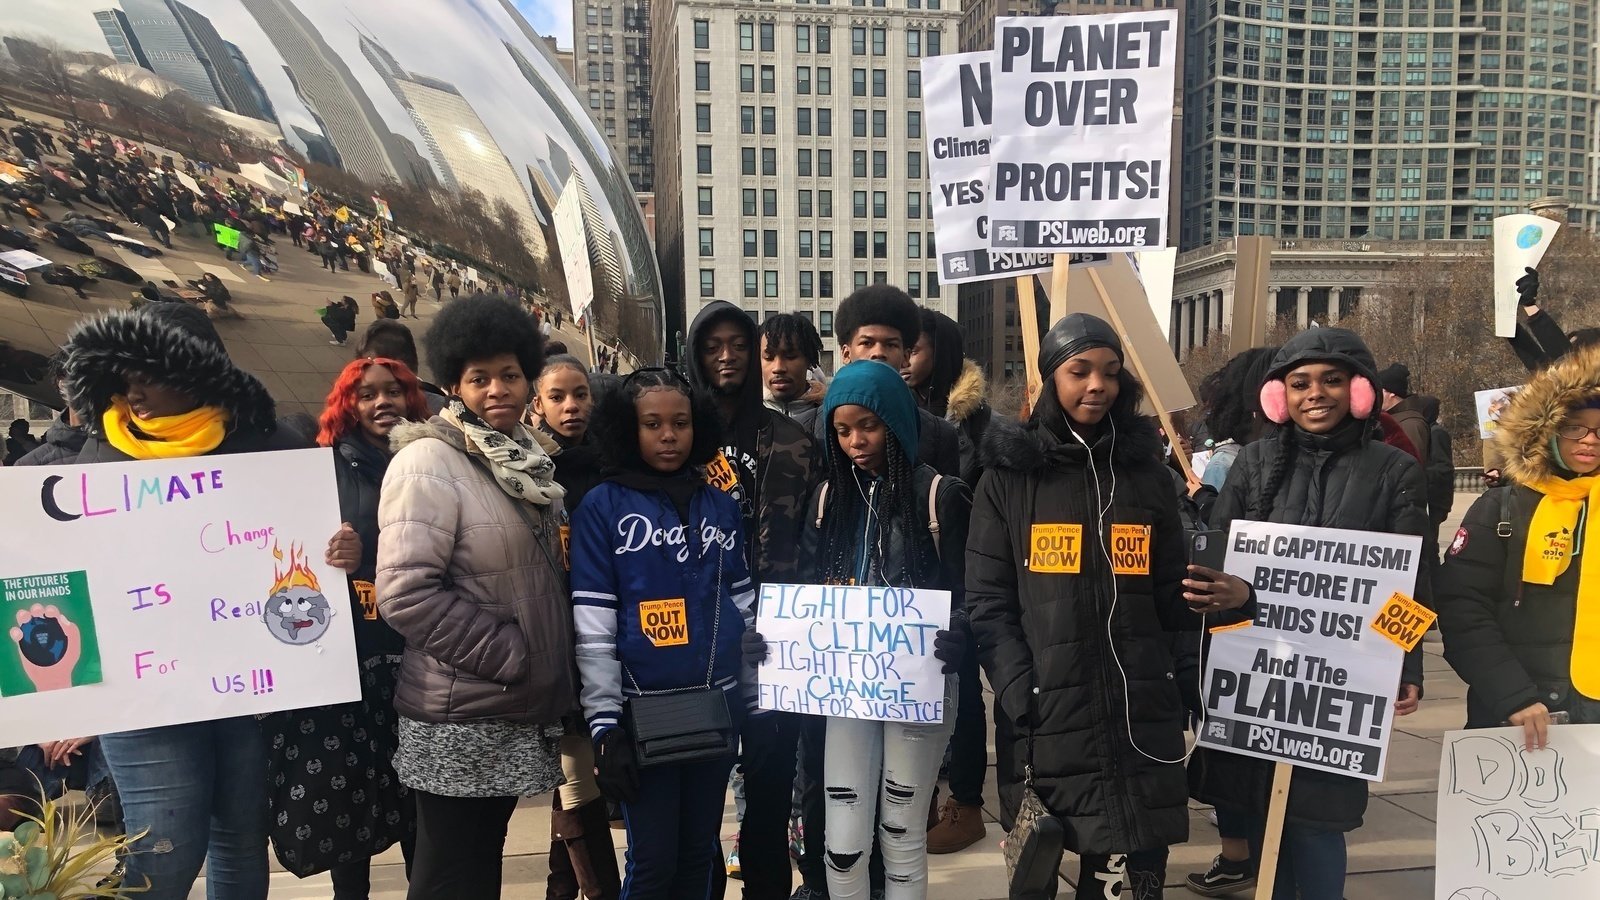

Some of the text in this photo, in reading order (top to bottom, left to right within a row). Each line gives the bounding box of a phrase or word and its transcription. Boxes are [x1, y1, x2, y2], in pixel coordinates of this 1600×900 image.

[1001, 20, 1170, 73] PLANET
[959, 62, 993, 128] N
[1025, 78, 1139, 127] OVER
[933, 137, 991, 160] Clima
[940, 179, 985, 207] YES
[995, 160, 1162, 202] PROFITS!
[998, 227, 1018, 241] PSL
[1038, 220, 1147, 246] PSLweb.org
[706, 460, 725, 478] UT
[710, 469, 733, 489] OW
[41, 469, 223, 521] CLIMATE
[200, 520, 275, 553] Change
[1036, 536, 1075, 551] OUT
[1115, 537, 1145, 552] OUT
[1032, 552, 1078, 567] NOW
[1114, 553, 1148, 568] NOW
[1234, 532, 1412, 572] End CAPITALISM!
[3, 574, 69, 590] THE FUTURE IS
[5, 585, 71, 601] IN OUR HANDS
[1254, 566, 1378, 605] BEFORE IT
[127, 583, 172, 611] IS
[211, 598, 261, 621] Real
[759, 585, 923, 619] FIGHT FOR
[646, 610, 681, 627] OUT
[1253, 603, 1316, 635] ENDS
[1320, 611, 1363, 641] US!
[1374, 612, 1420, 645] NOW
[1388, 603, 1426, 631] OUT
[645, 624, 686, 642] NOW
[808, 621, 940, 656] CLIMAT
[134, 651, 180, 679] For
[849, 652, 902, 680] FOR
[1251, 648, 1348, 686] And The
[806, 675, 917, 702] CHANGE
[759, 684, 943, 722] FIGH FOR JUSTICE
[1207, 668, 1388, 740] PLANET!
[1246, 725, 1365, 773] PSLweb.org
[1451, 736, 1560, 803] DO
